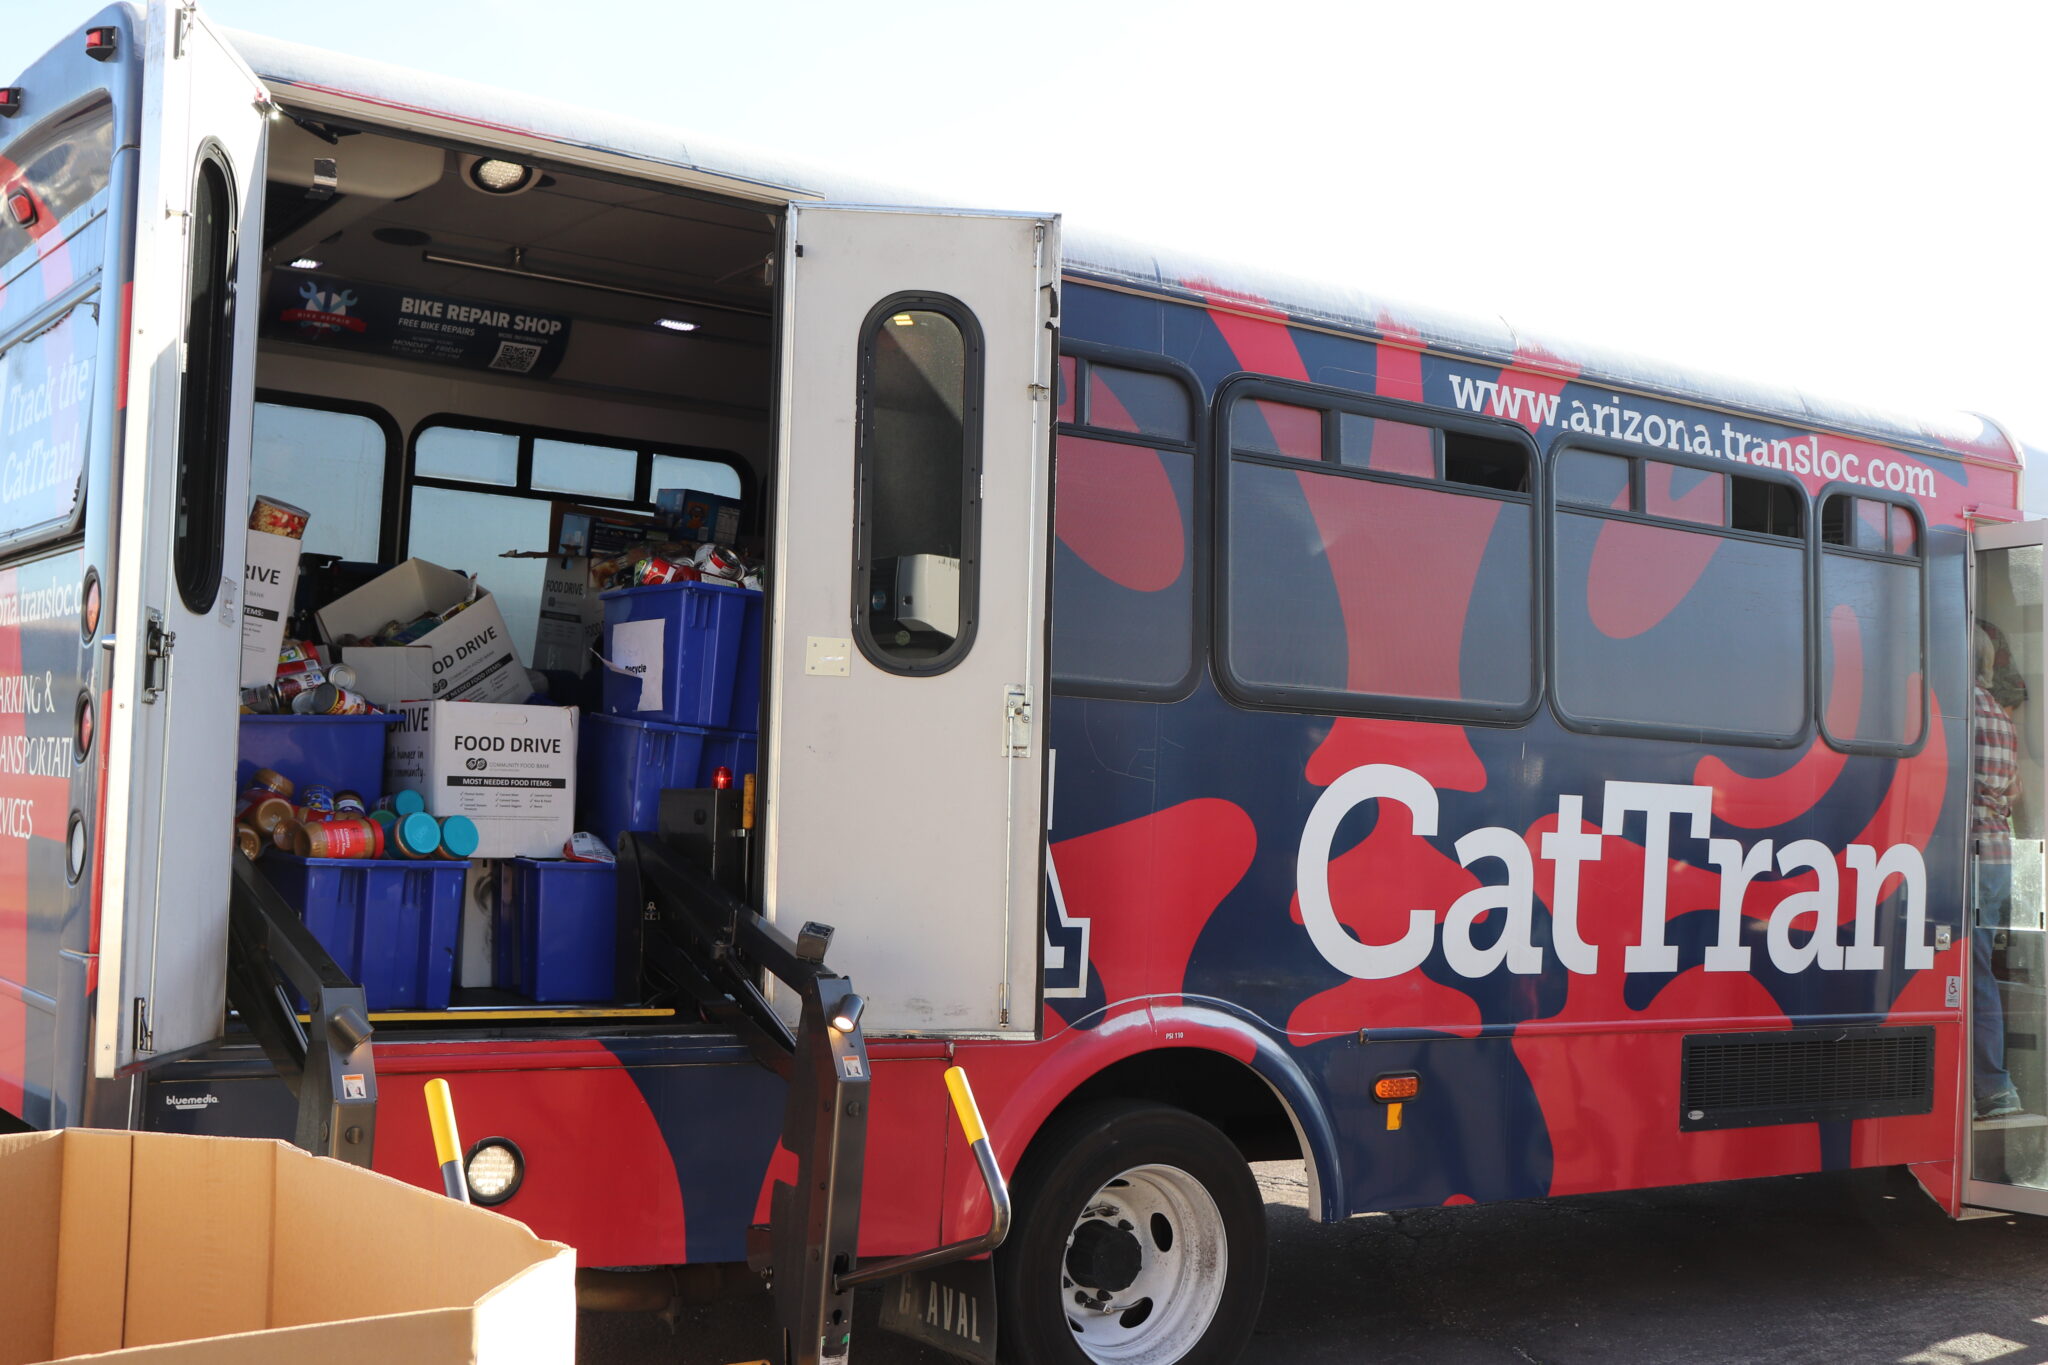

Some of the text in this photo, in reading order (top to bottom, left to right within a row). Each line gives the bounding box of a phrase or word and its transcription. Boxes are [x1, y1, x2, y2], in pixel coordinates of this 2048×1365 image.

[398, 318, 476, 337] FREE BIKE REPAIRS
[400, 297, 562, 335] BIKE REPAIR SHOP
[8, 352, 90, 436] Track the
[1448, 373, 1937, 498] www.arizona.transloc.com
[2, 421, 79, 504] CatTran!
[546, 580, 584, 596] FOOD DRIVE
[456, 626, 498, 660] DRIVE
[44, 670, 56, 714] &
[417, 746, 424, 760] in
[454, 736, 561, 754] FOOD DRIVE
[489, 761, 519, 769] COMMUNITY
[462, 777, 482, 786] MOST
[484, 778, 510, 787] NEEDED
[531, 780, 552, 788] ITEMS:
[0, 797, 33, 841] VICES
[1296, 763, 1935, 979] CatTran
[1175, 1031, 1184, 1039] 110
[166, 1094, 218, 1105] bluemedia
